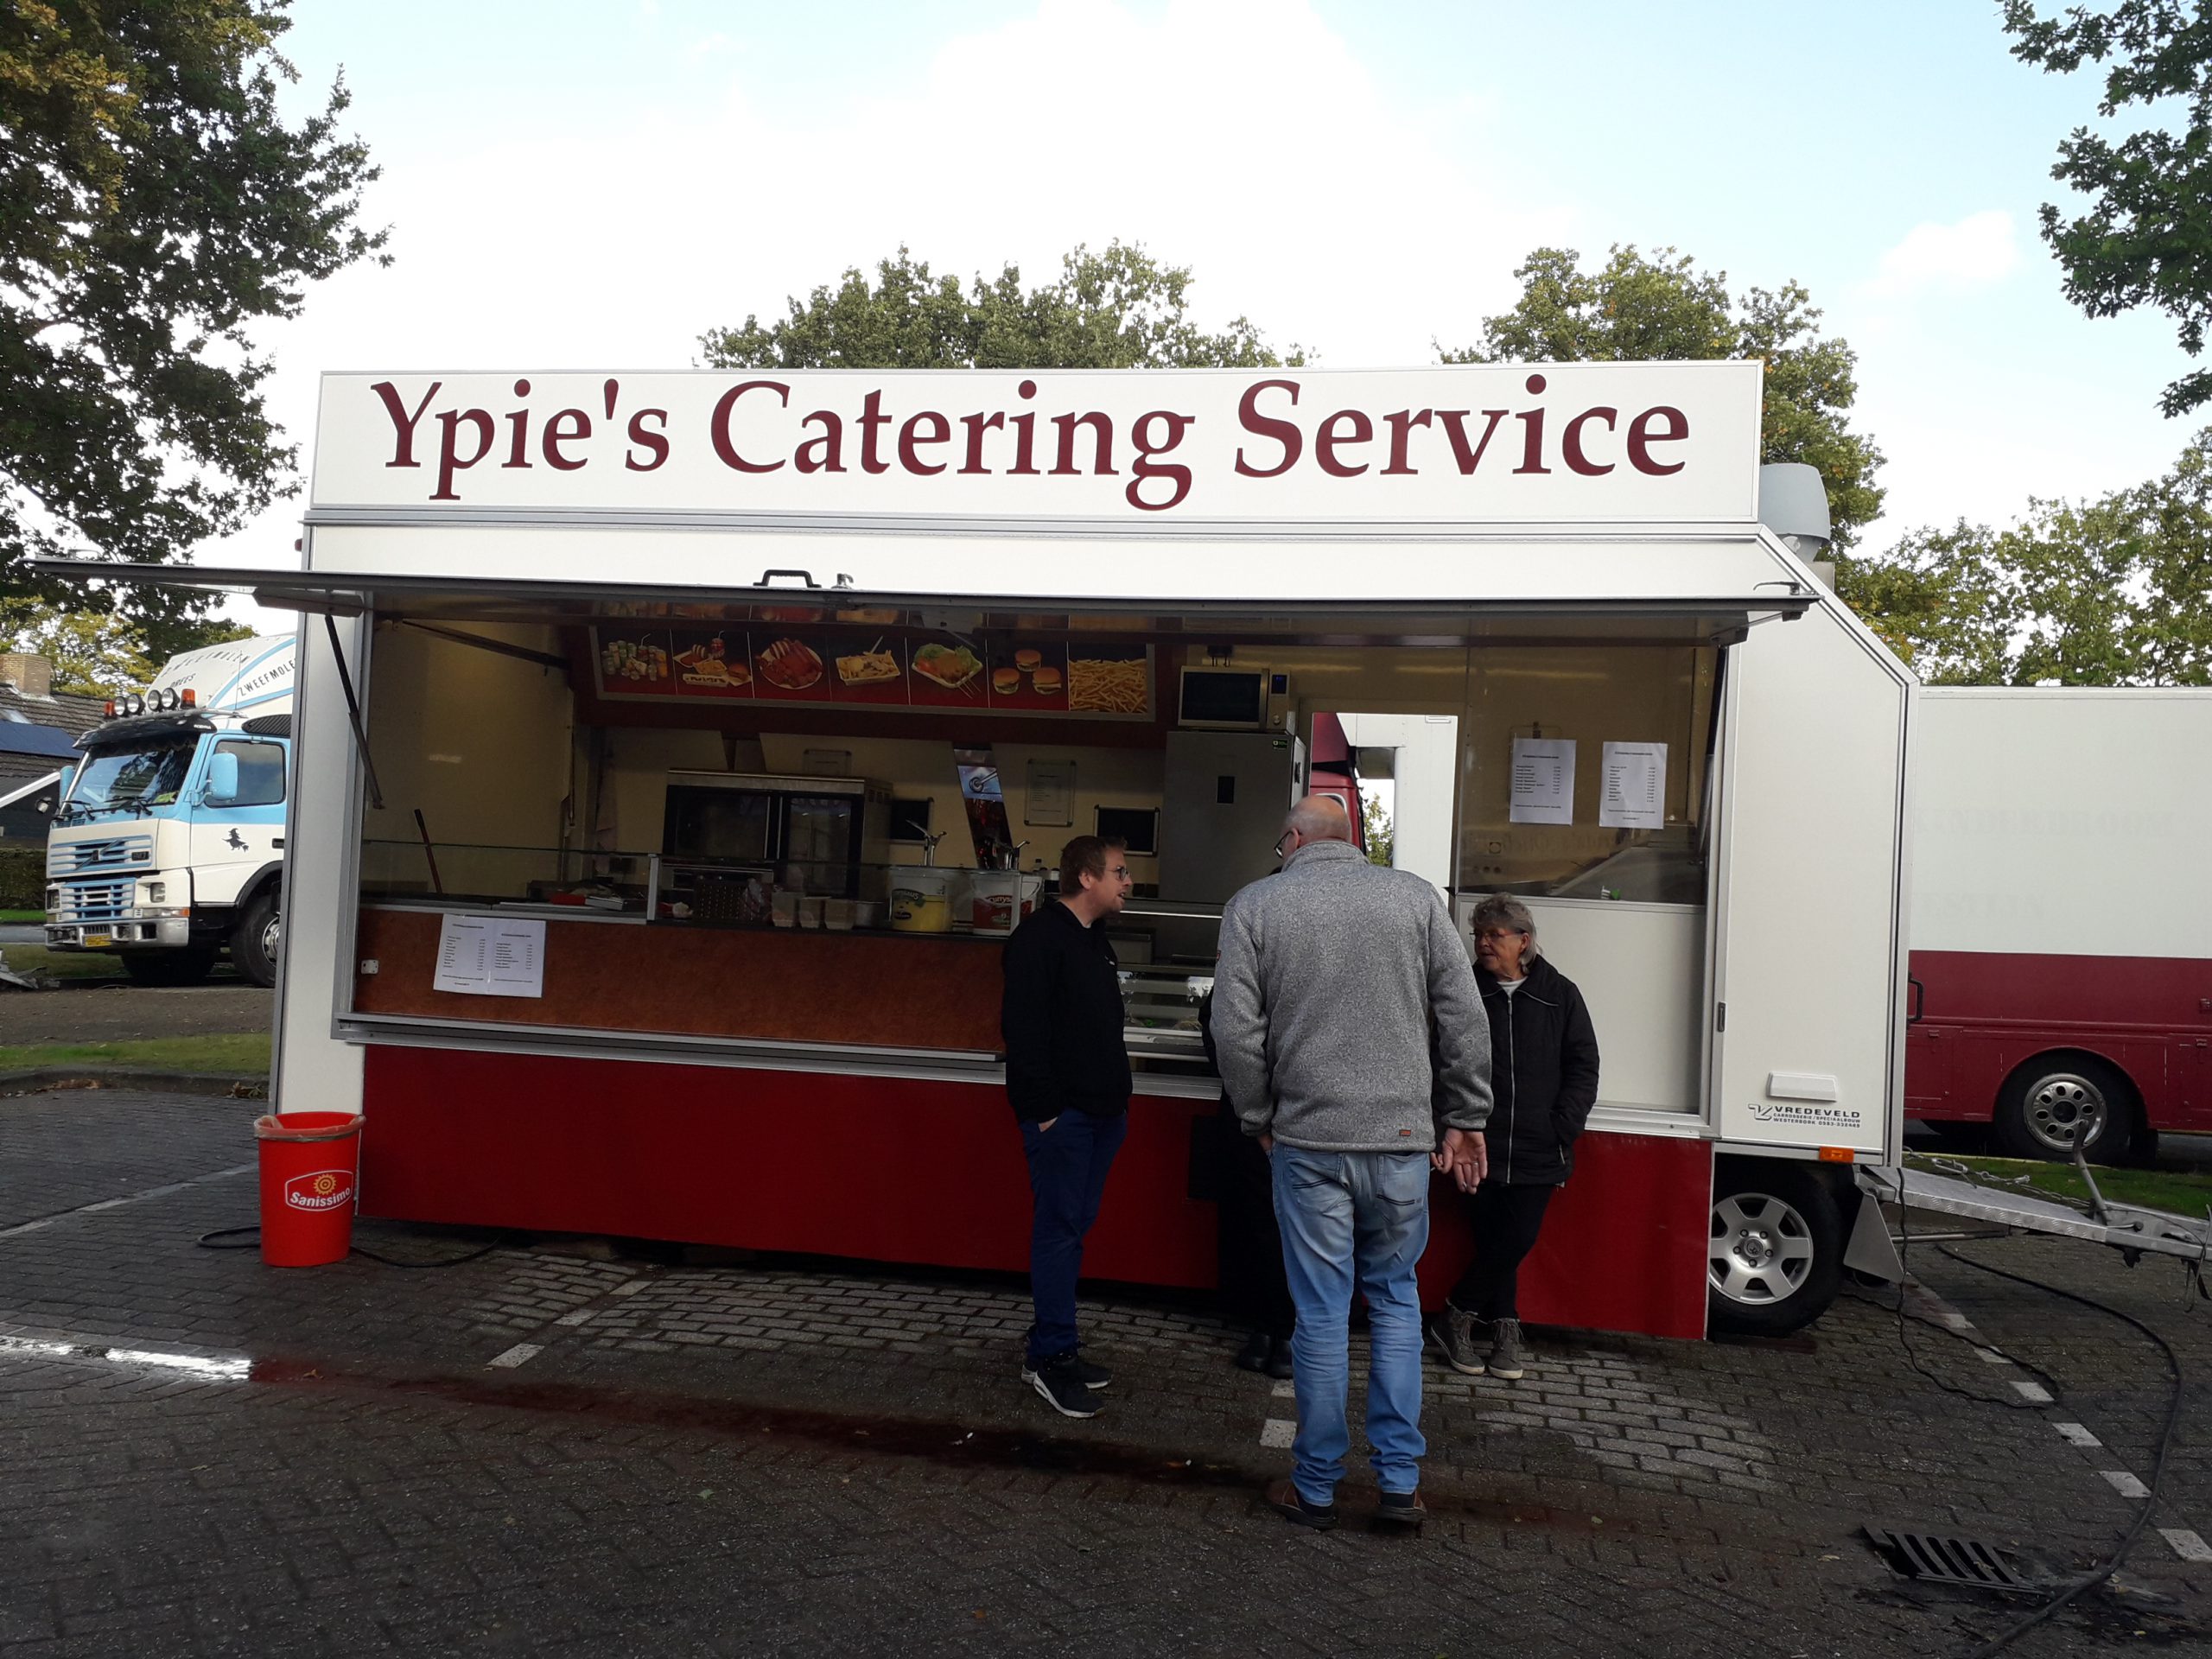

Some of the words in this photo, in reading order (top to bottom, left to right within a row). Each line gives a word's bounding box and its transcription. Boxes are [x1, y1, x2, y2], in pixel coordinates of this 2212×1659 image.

[370, 378, 670, 501] Ypie's
[709, 378, 1196, 512] Catering
[1234, 373, 1690, 478] Service
[238, 657, 296, 696] ZWEEFMOLE
[1774, 1106, 1860, 1118] VREDEVELD
[290, 1187, 350, 1207] Sanissimo
